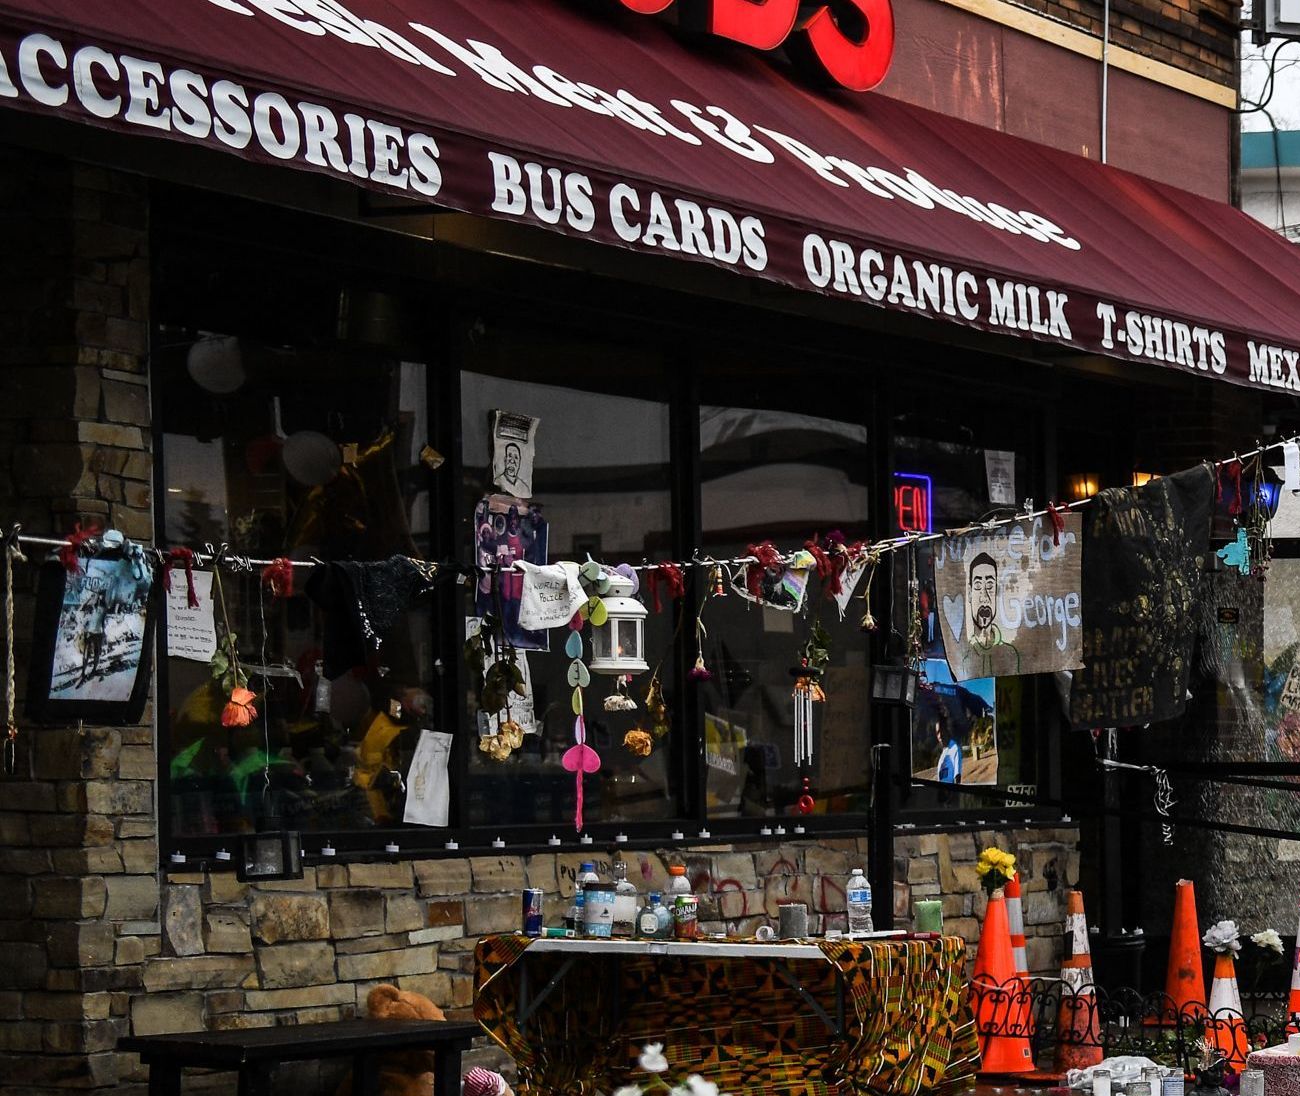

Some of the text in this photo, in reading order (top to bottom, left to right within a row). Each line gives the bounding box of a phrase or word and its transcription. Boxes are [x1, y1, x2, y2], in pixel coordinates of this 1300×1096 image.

[464, 38, 702, 146] Meat
[753, 123, 1081, 251] Produce
[489, 151, 595, 233] BUS
[609, 185, 768, 272] CARDS
[802, 233, 979, 320] ORGANIC
[986, 278, 1073, 341] MILK
[1097, 302, 1227, 376] T-SHIRTS
[894, 485, 928, 532] EN
[1000, 565, 1082, 651] George
